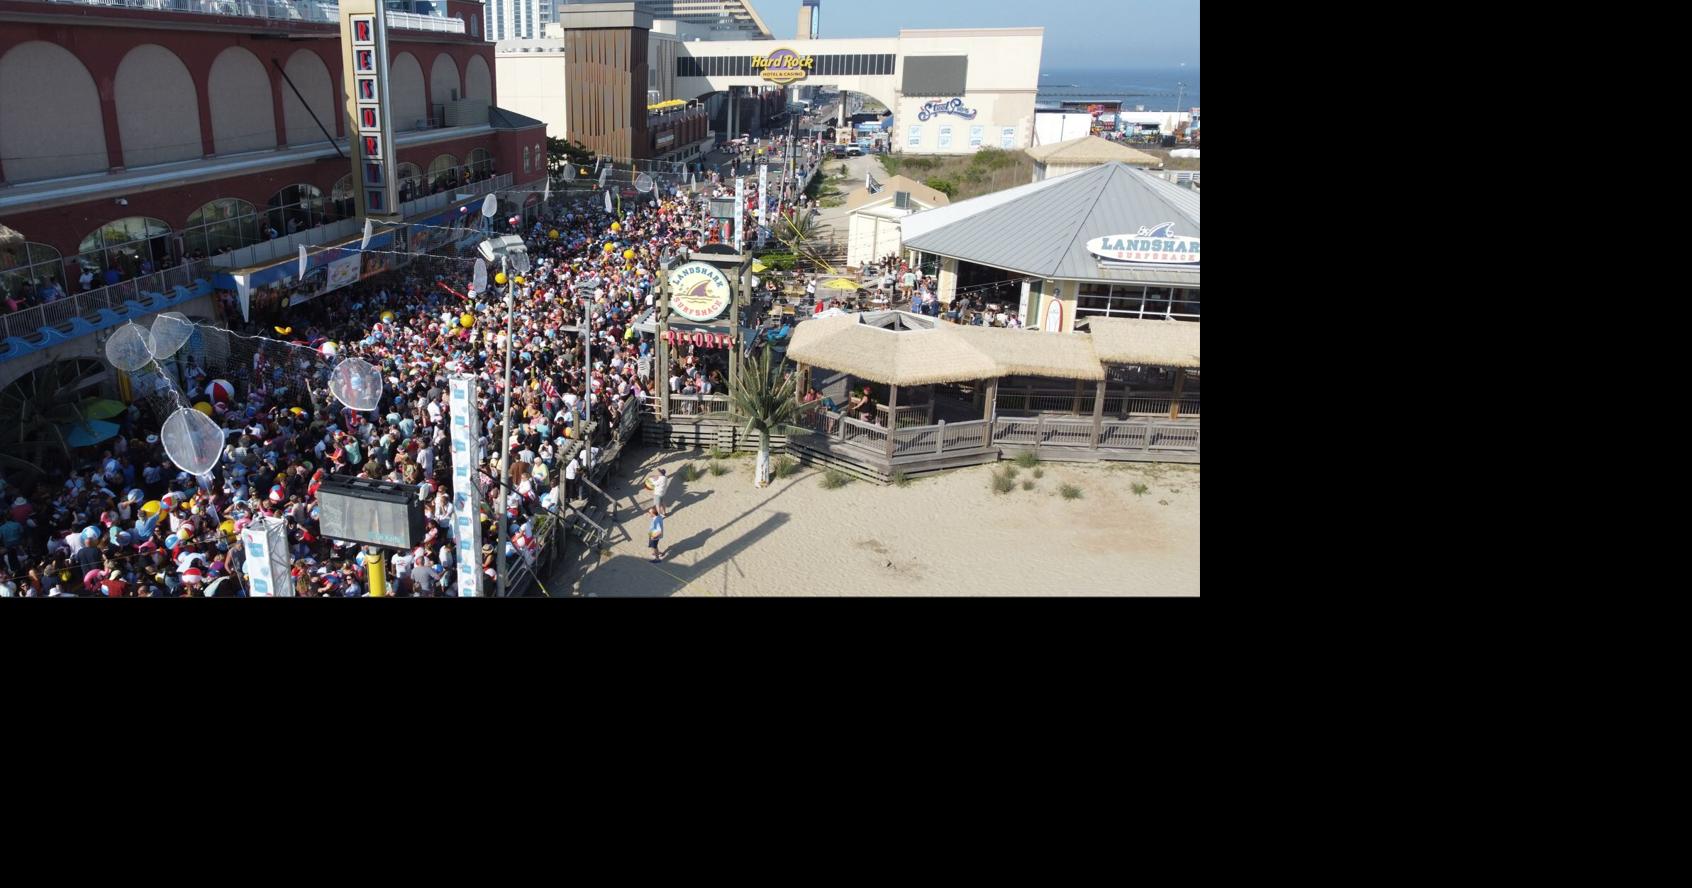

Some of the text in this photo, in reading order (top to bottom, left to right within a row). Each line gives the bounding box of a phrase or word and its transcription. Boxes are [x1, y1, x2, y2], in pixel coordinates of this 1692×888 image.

[751, 54, 814, 69] Hard Rock
[1101, 238, 1199, 252] LANDSHAR
[672, 266, 724, 288] LANDSHARK
[673, 296, 723, 317] SURFSHACK
[667, 330, 734, 350] RESORTS
